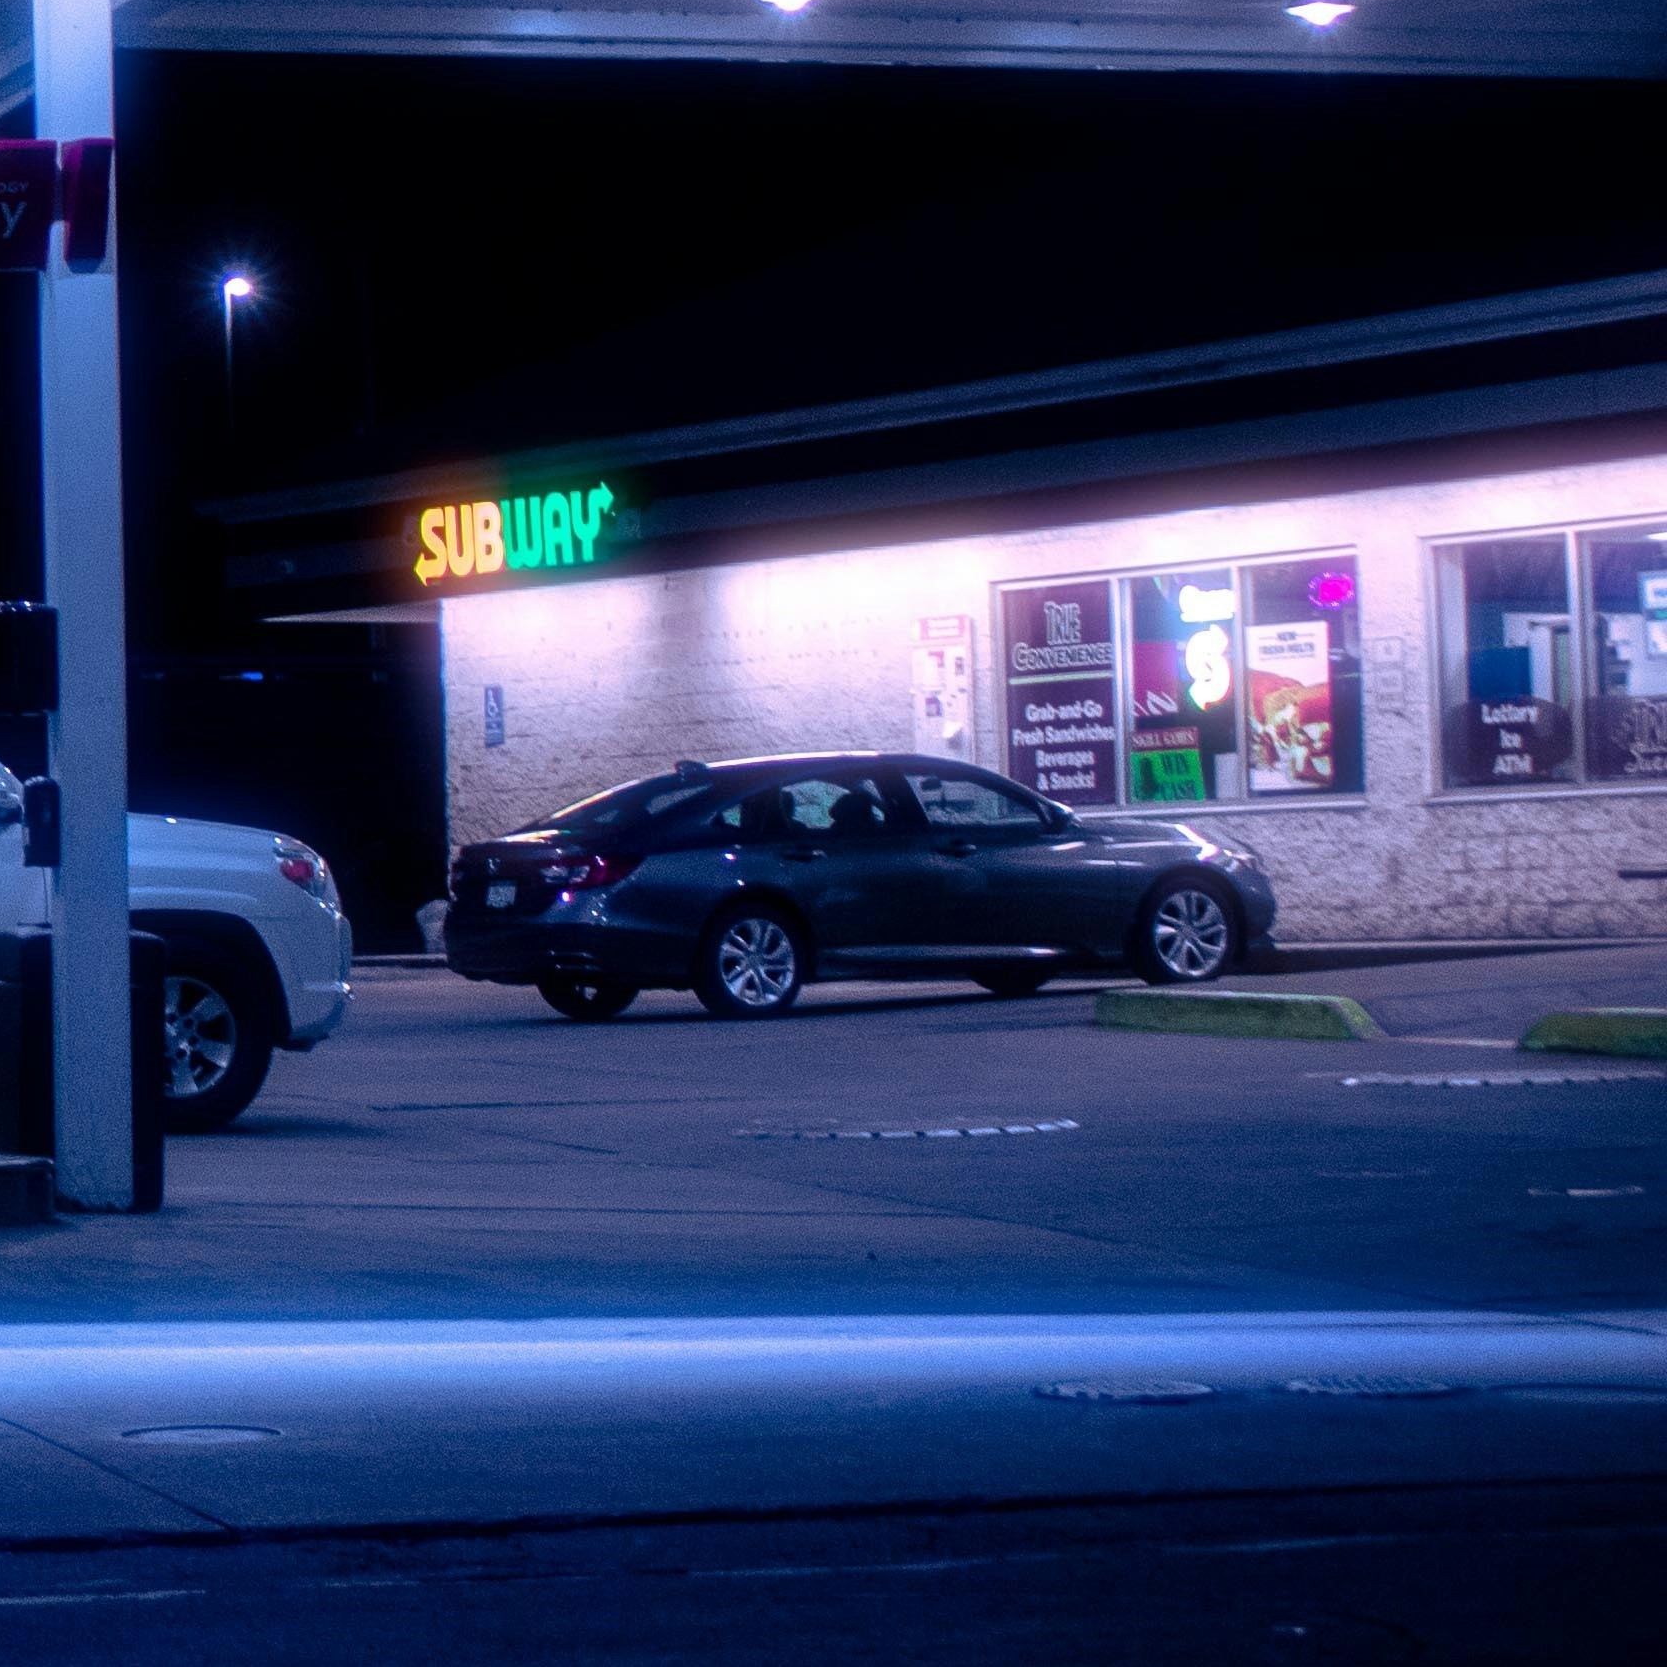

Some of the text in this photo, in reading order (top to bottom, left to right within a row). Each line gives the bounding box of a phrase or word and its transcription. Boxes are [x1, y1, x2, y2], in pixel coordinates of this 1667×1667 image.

[413, 480, 616, 587] SUBWAY
[1481, 703, 1540, 726] Lottery
[1492, 753, 1533, 775] ATM
